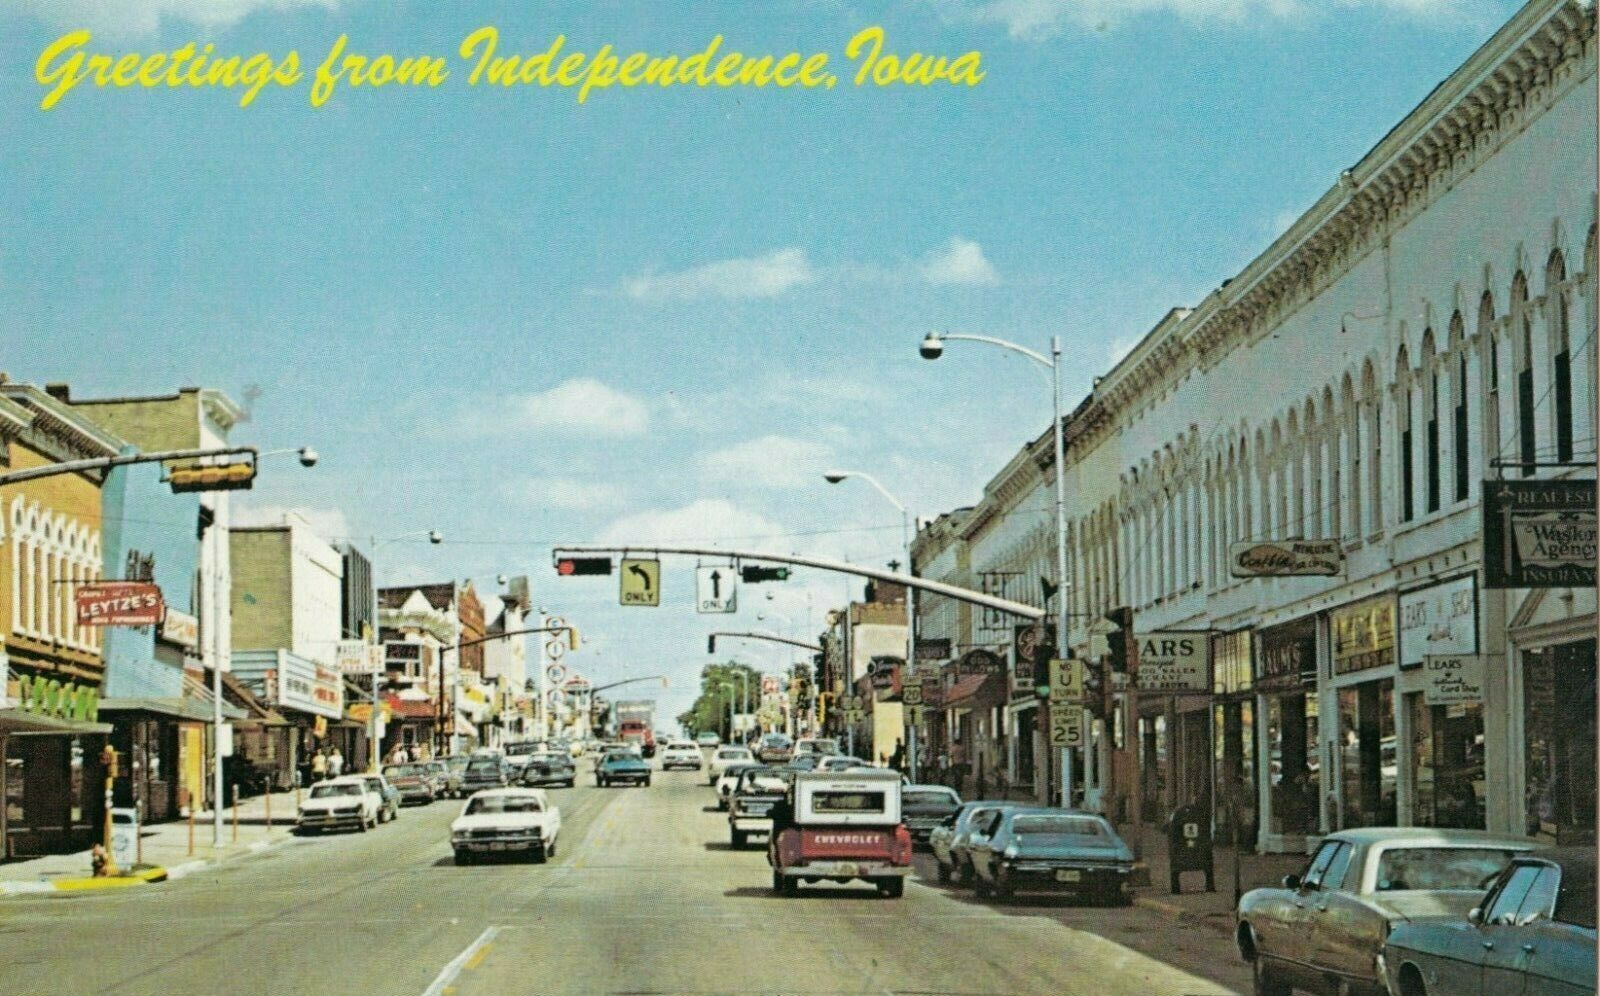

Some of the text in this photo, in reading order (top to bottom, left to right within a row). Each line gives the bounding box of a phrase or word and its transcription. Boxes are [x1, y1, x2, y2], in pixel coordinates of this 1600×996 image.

[625, 592, 653, 602] ONLY
[80, 592, 157, 617] LEYTZE'S
[703, 600, 732, 610] ONLY
[1059, 663, 1072, 671] NO
[1427, 655, 1462, 670] LEARS
[1059, 674, 1072, 686] U
[1054, 688, 1080, 696] TURN
[1052, 708, 1082, 716] SPEED
[1053, 726, 1080, 742] 25
[814, 835, 880, 843] CHEVROLET
